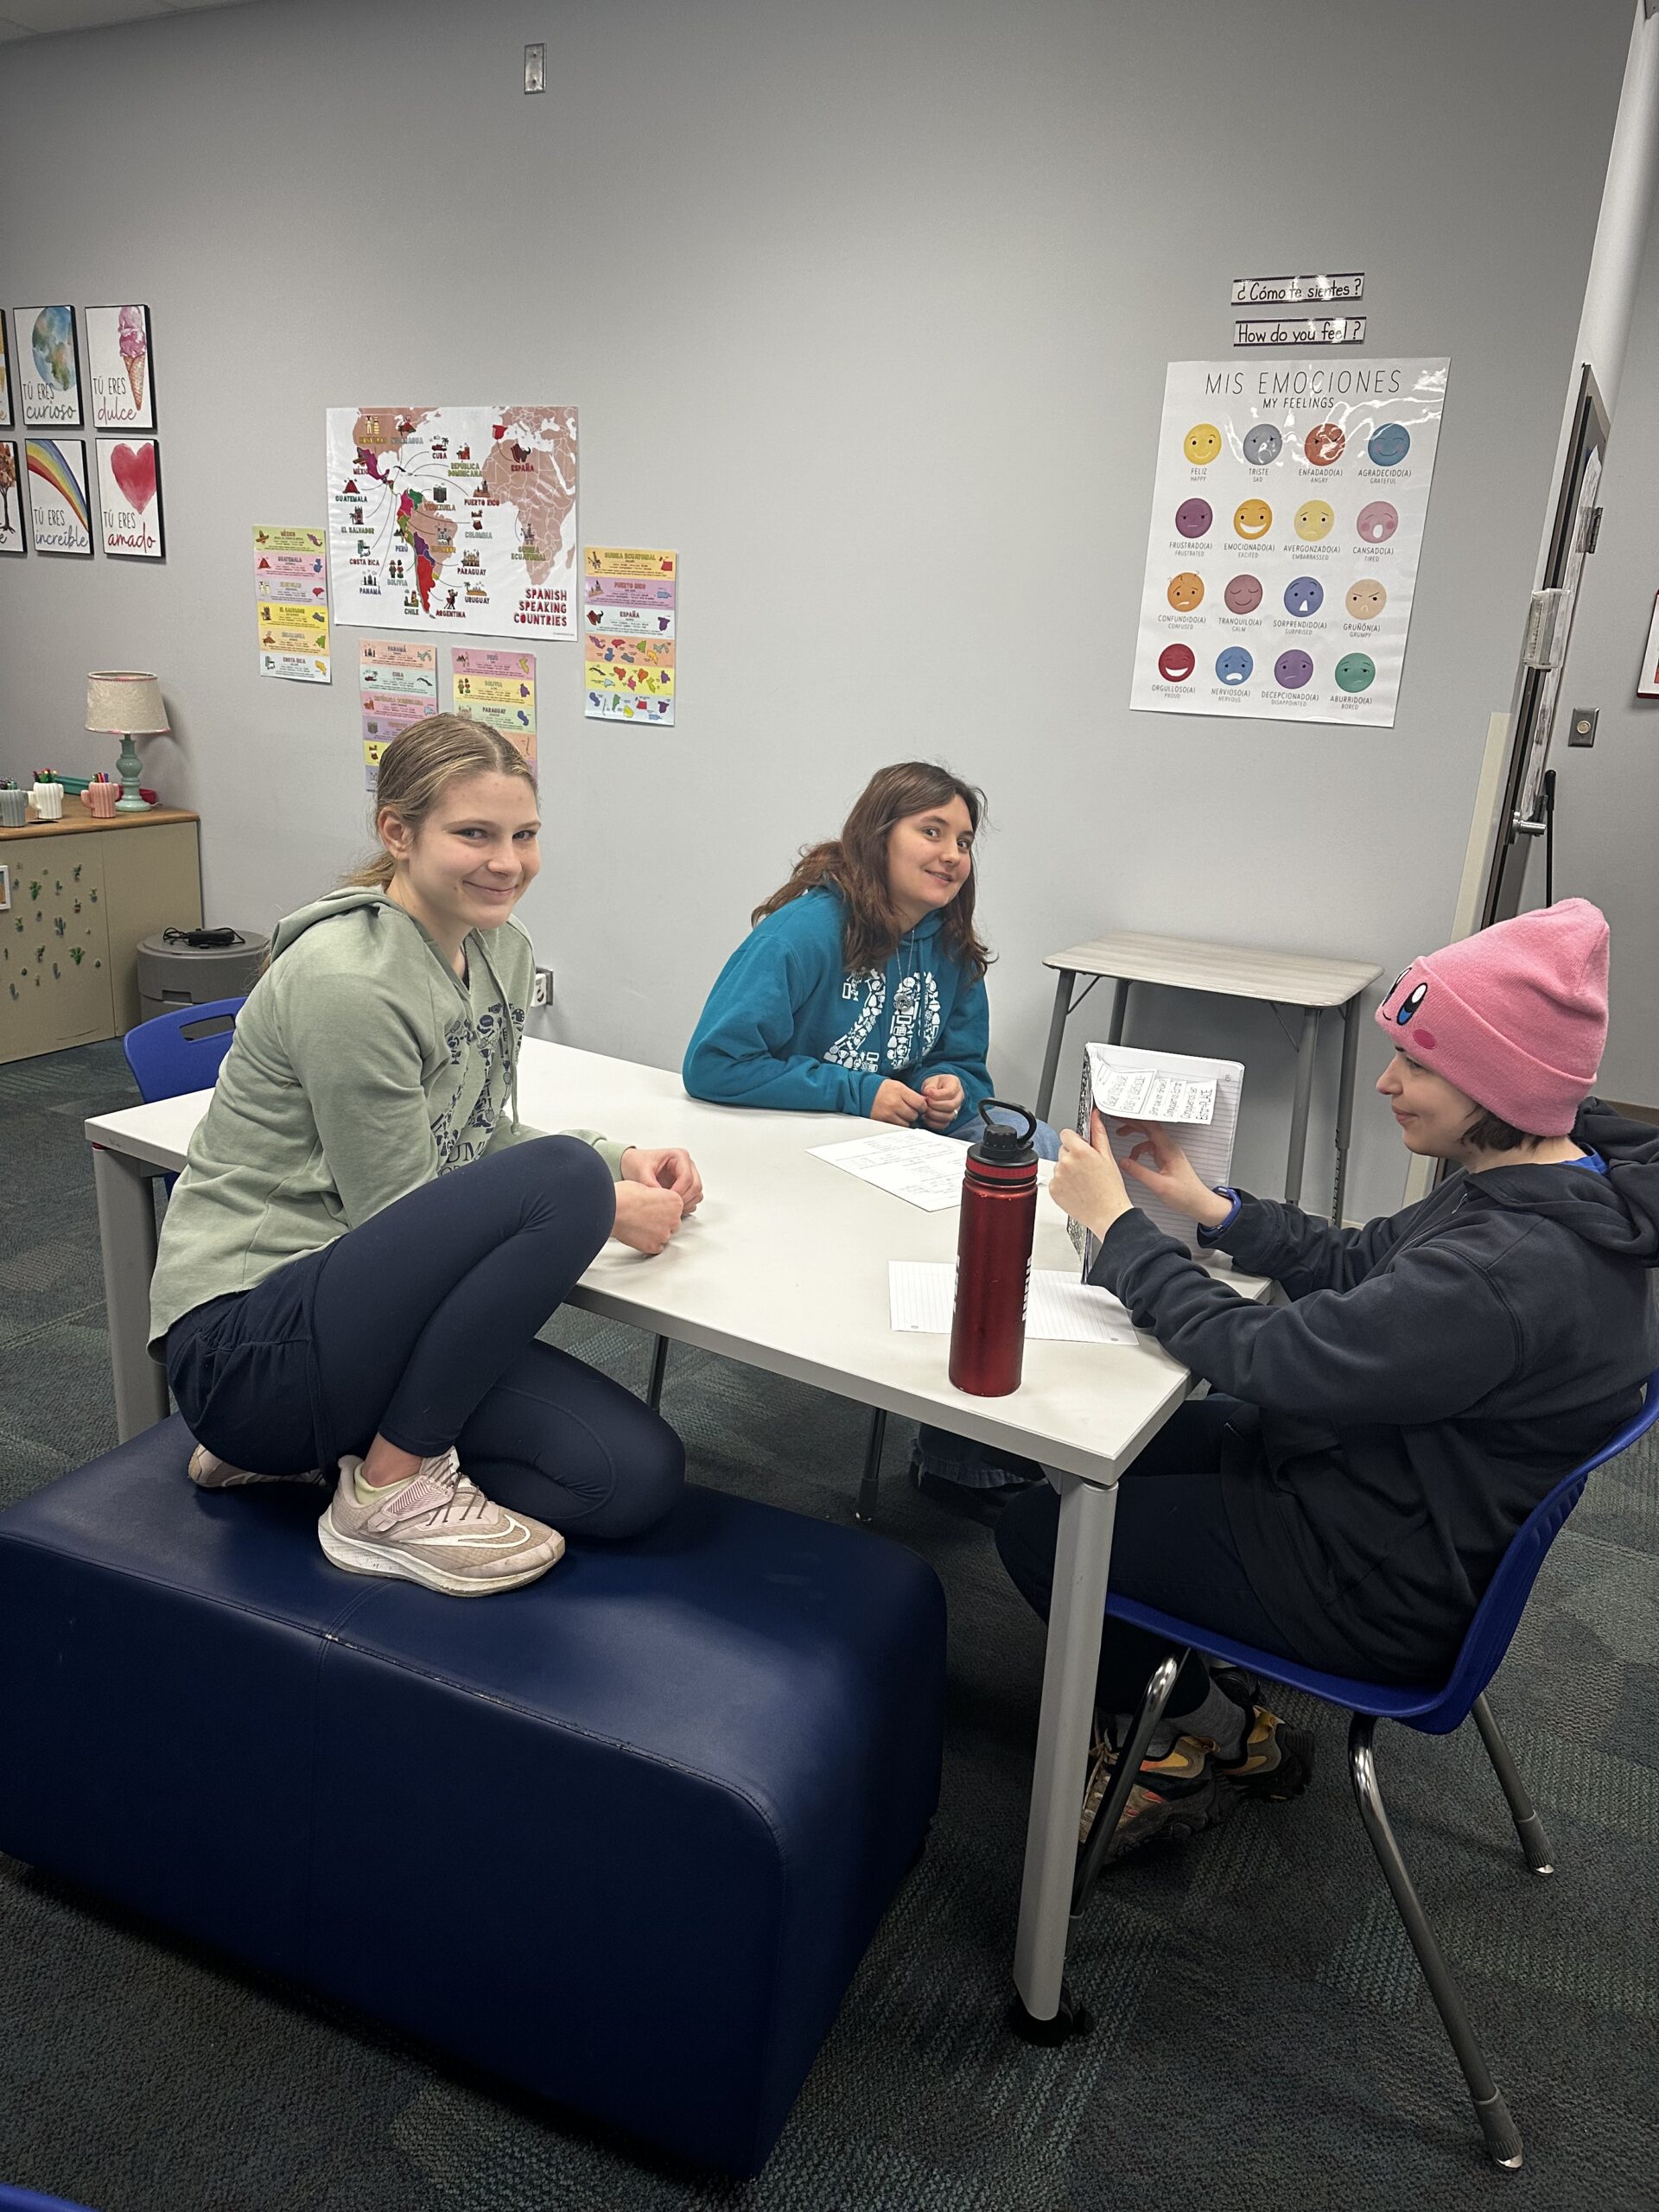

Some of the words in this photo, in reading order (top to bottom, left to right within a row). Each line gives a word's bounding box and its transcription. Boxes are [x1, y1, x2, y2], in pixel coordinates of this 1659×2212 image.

[1290, 281, 1302, 298] te
[1238, 323, 1266, 343] How
[1270, 323, 1287, 342] do
[1293, 329, 1316, 343] you
[108, 378, 126, 395] ERES
[1205, 372, 1244, 395] MIS
[1258, 370, 1402, 395] EMOCIONES
[37, 383, 54, 400] ERES
[1262, 397, 1278, 409] MY
[1283, 397, 1335, 409] FEELINGS
[27, 400, 76, 420] curioso
[98, 396, 137, 425] dulce
[511, 463, 534, 473] ESPAÑA
[1249, 467, 1268, 476] TRISTE
[48, 509, 65, 525] ERES
[104, 509, 113, 528] TÚ
[118, 512, 136, 529] ERES
[35, 524, 88, 549] increíble
[108, 521, 156, 554] amado
[395, 543, 409, 552] PERÚ
[1224, 543, 1275, 552] EMOCIONADO(A)
[1283, 545, 1341, 554] AVERGONZADO(A)
[1352, 546, 1394, 555] CANSADO(A)
[457, 568, 486, 576] PARAGUAY
[387, 578, 408, 587] BOLIVIA
[359, 586, 381, 595] PANAMÁ
[524, 588, 568, 601] SPANISH
[465, 596, 490, 605] URUGUAY
[518, 601, 567, 613] SPEAKING
[435, 609, 467, 619] ARGENTINA
[1158, 614, 1206, 624] CONFUNDIDO(A)
[514, 613, 568, 626] COUNTRIES
[1218, 617, 1262, 626] TRANQUILO(A)
[1273, 620, 1327, 629] SORPRENDIDO(A)
[1343, 622, 1381, 632] GRUÑÓN(A)
[1151, 684, 1196, 694] ORGULLOSO(A)
[1211, 688, 1251, 697] NERVIOSO(A)
[1261, 691, 1319, 702] DECEPCIONADO(A)
[1330, 696, 1373, 705] ABURRIDO(A)
